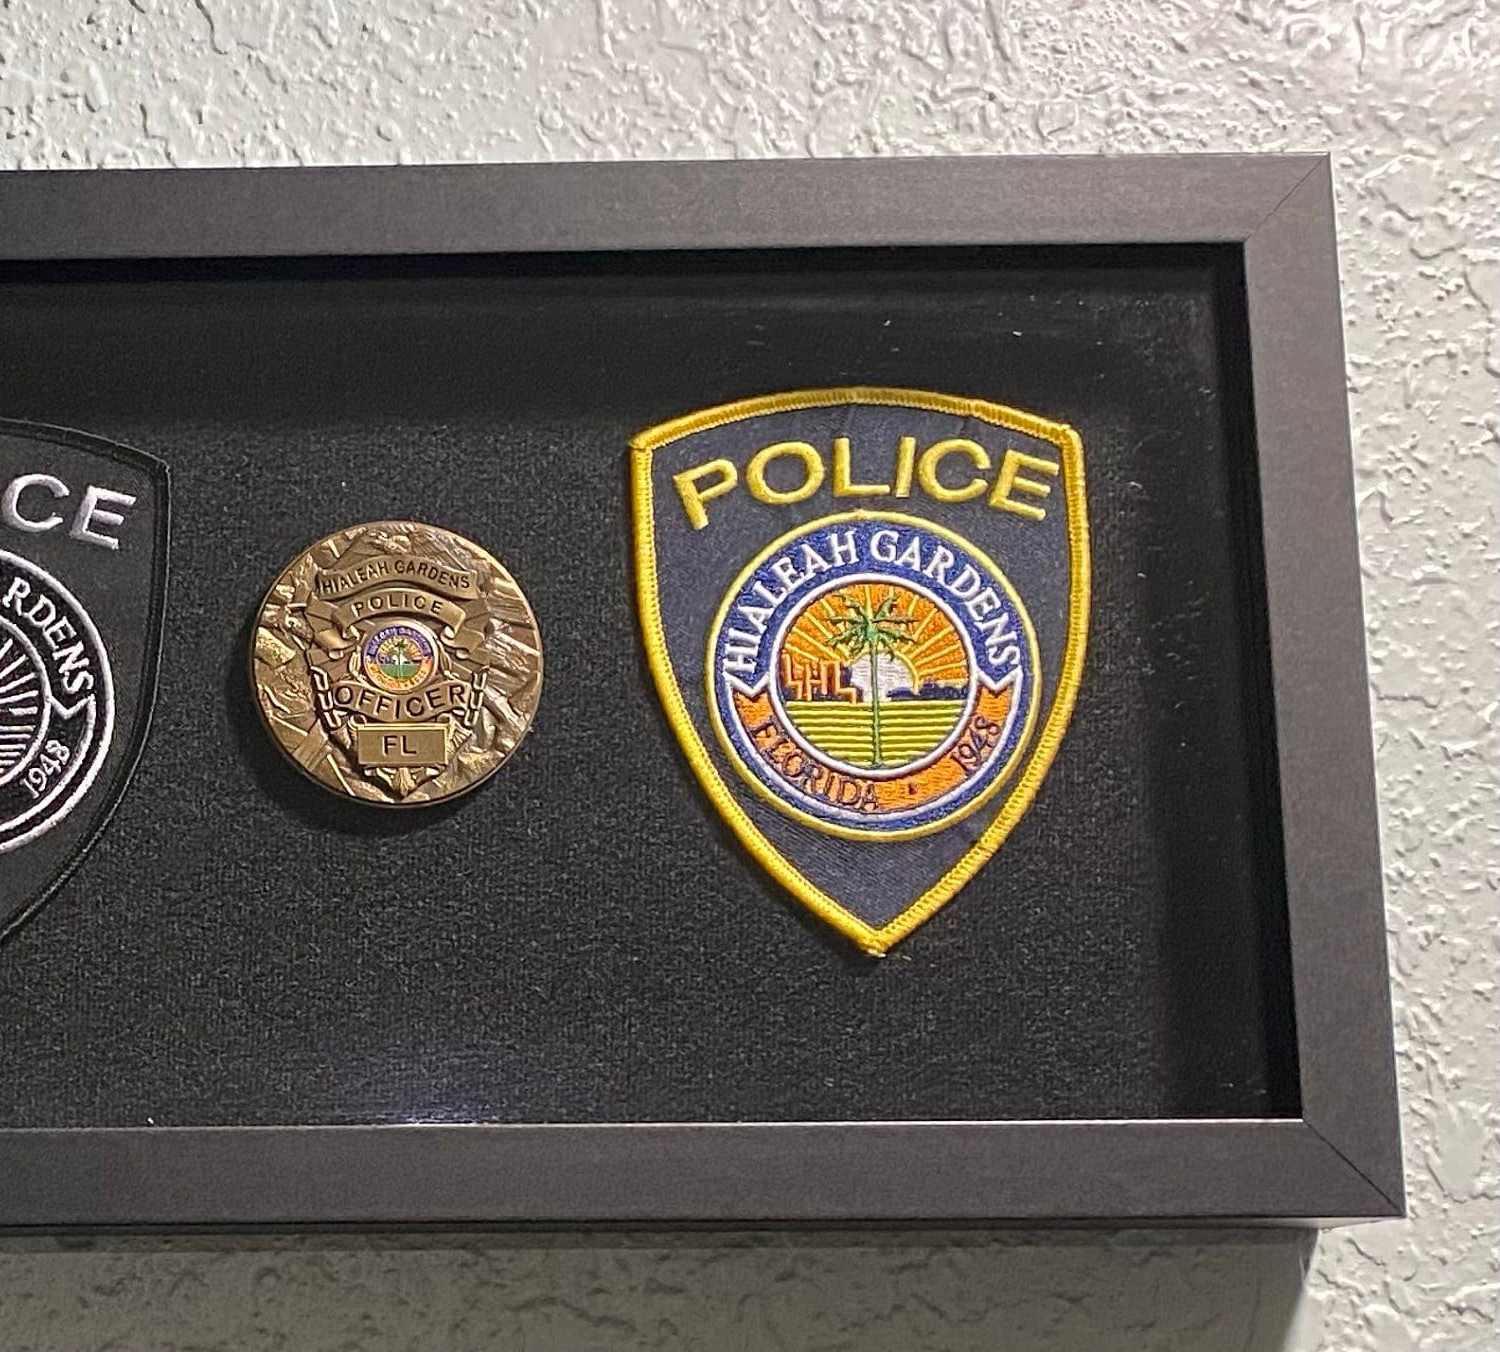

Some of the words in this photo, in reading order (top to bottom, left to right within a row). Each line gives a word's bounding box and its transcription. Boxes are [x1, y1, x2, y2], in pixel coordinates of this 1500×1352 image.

[673, 436, 1059, 530] POLICE
[322, 564, 389, 593] HIALEAH
[394, 559, 470, 589] GARDENS
[353, 595, 443, 617] POLICE
[722, 530, 857, 672] HIALEAH
[870, 529, 1023, 668] GARDENS
[335, 684, 466, 719] OFFICER
[20, 738, 72, 800] 1948
[382, 735, 417, 755] FL
[750, 717, 879, 810] FLORIDA
[951, 718, 1001, 772] 1948
